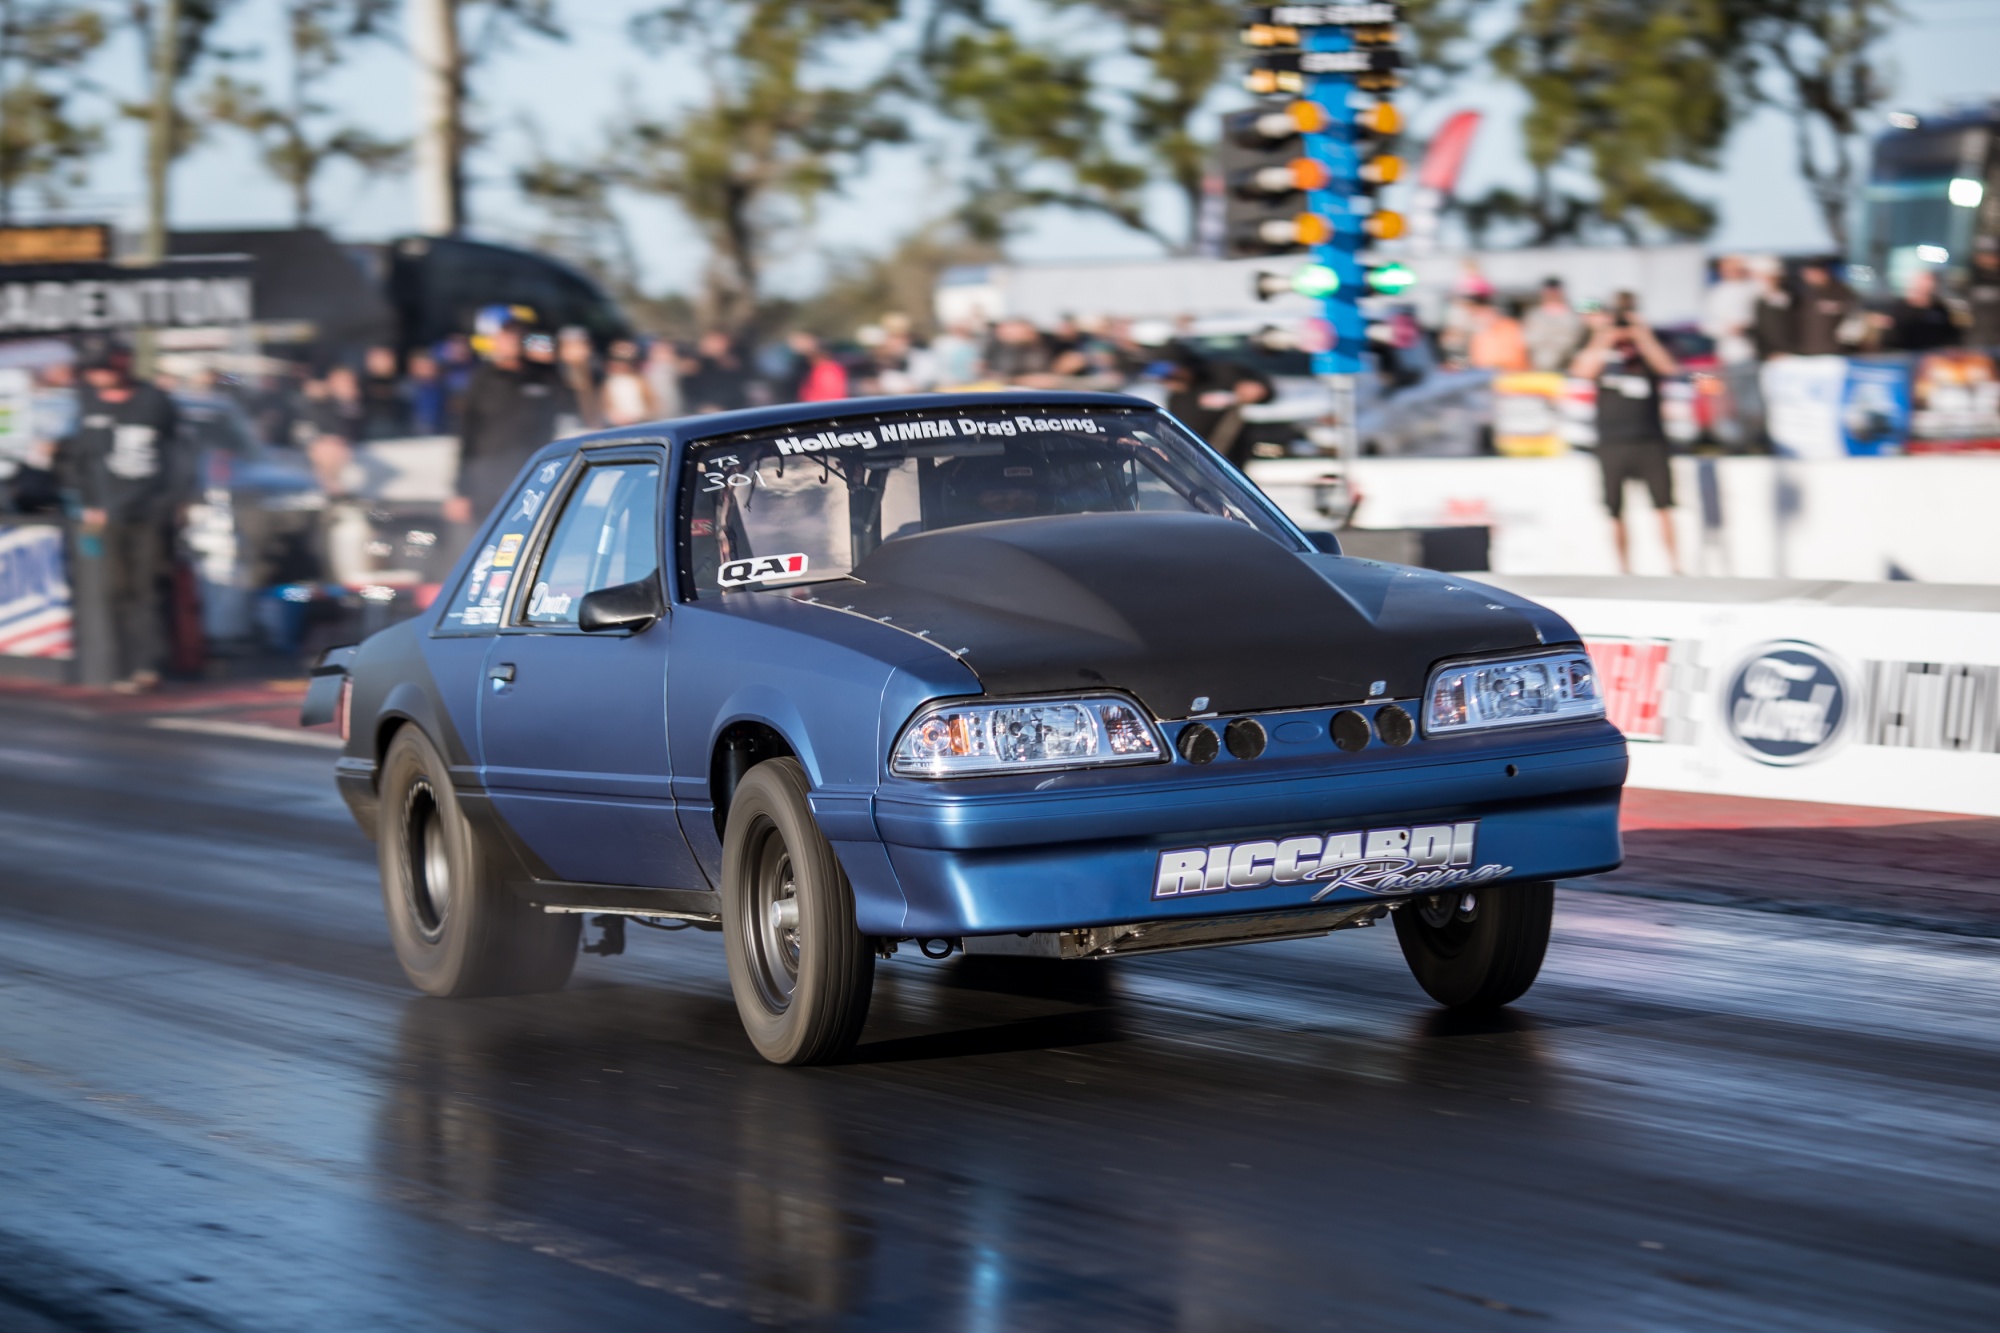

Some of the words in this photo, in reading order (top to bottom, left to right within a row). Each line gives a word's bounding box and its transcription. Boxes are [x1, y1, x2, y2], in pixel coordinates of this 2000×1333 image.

[774, 430, 878, 456] Holley
[879, 419, 956, 442] NMRA
[957, 418, 1018, 437] Drag
[708, 455, 740, 468] TS
[702, 470, 767, 492] 301
[722, 556, 803, 581] QA1
[1154, 821, 1479, 899] RICCARDI
[1303, 857, 1513, 901] Racing
